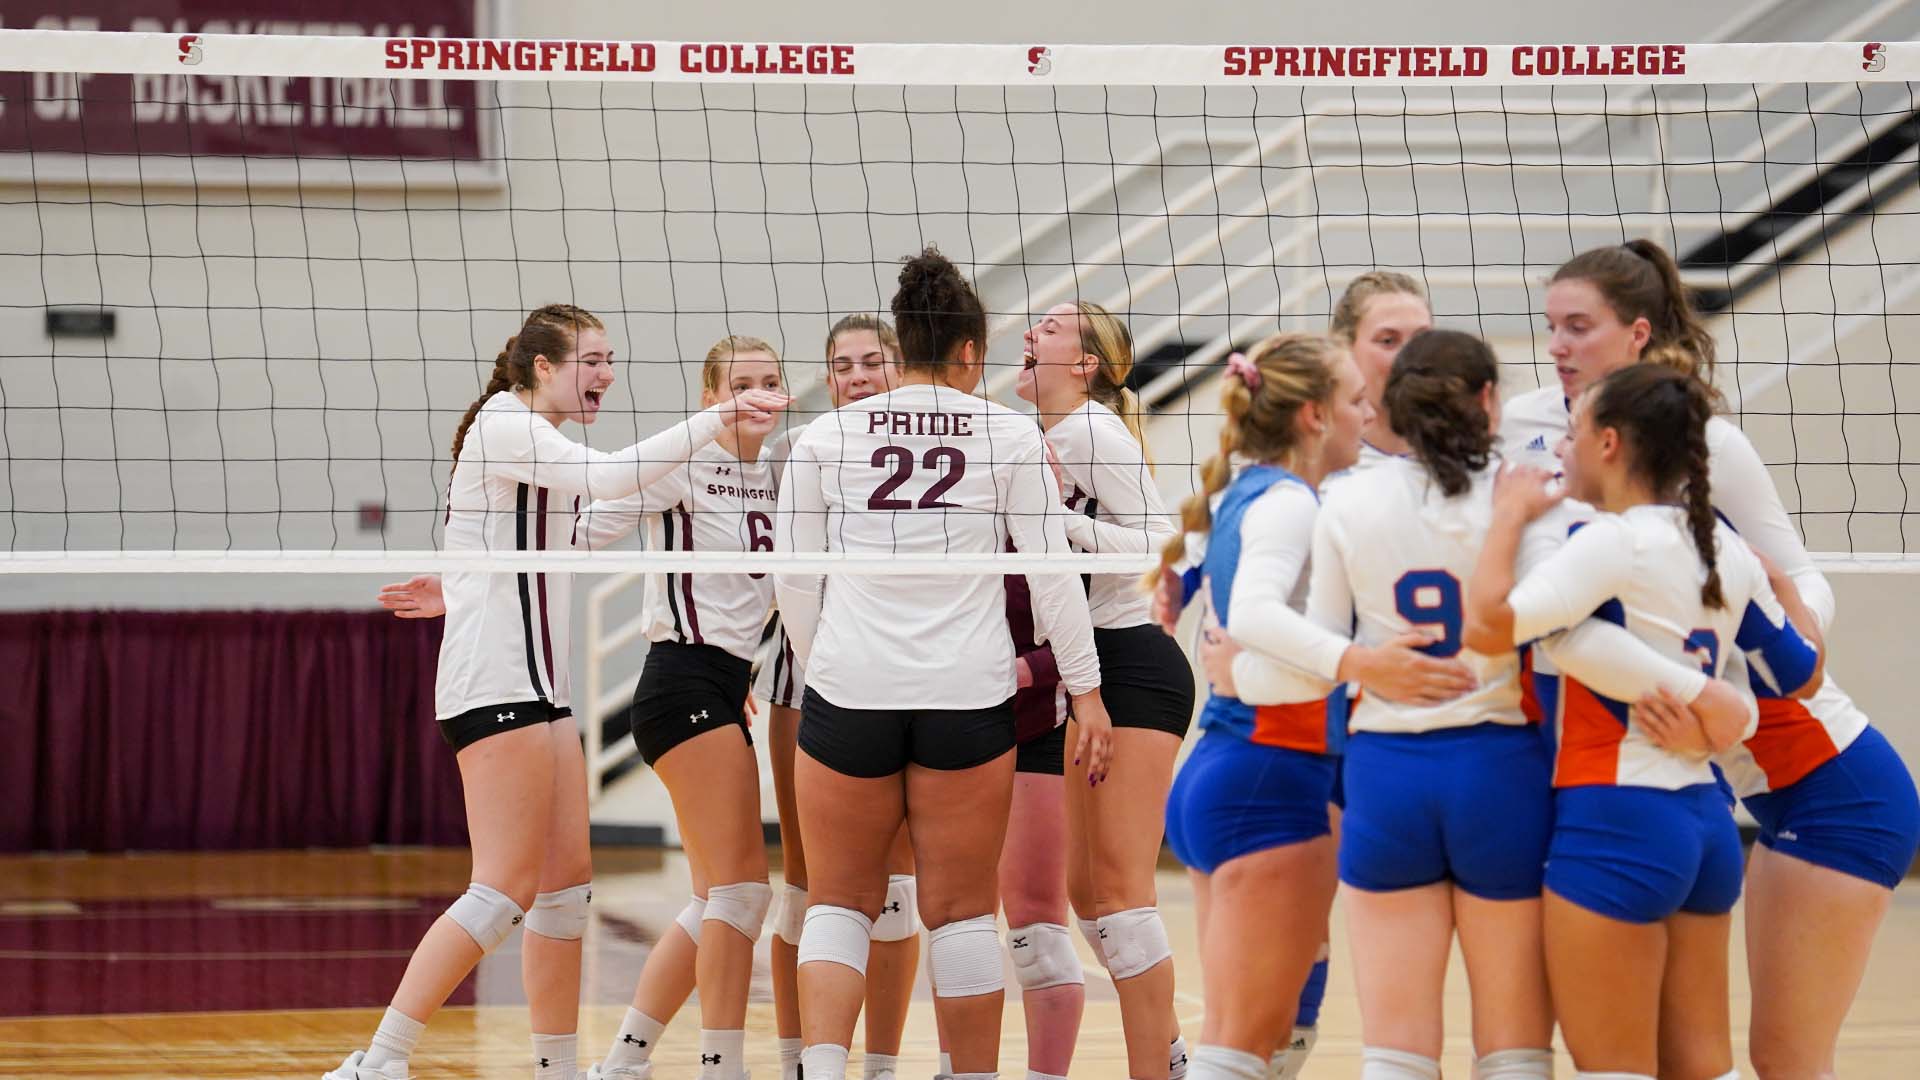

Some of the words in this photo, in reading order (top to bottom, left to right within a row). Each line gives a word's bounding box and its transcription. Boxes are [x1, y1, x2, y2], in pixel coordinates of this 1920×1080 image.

[178, 35, 203, 65] S
[385, 39, 656, 72] SPRINGFIELD
[680, 43, 855, 75] COLLEGE
[1028, 46, 1051, 76] S
[1223, 46, 1488, 77] SPRINGFIELD
[1512, 45, 1686, 76] COLLEGE
[1862, 42, 1886, 72] S
[867, 411, 973, 437] PRIDE
[867, 445, 966, 510] 22
[746, 510, 774, 580] 6
[1393, 569, 1463, 659] 9
